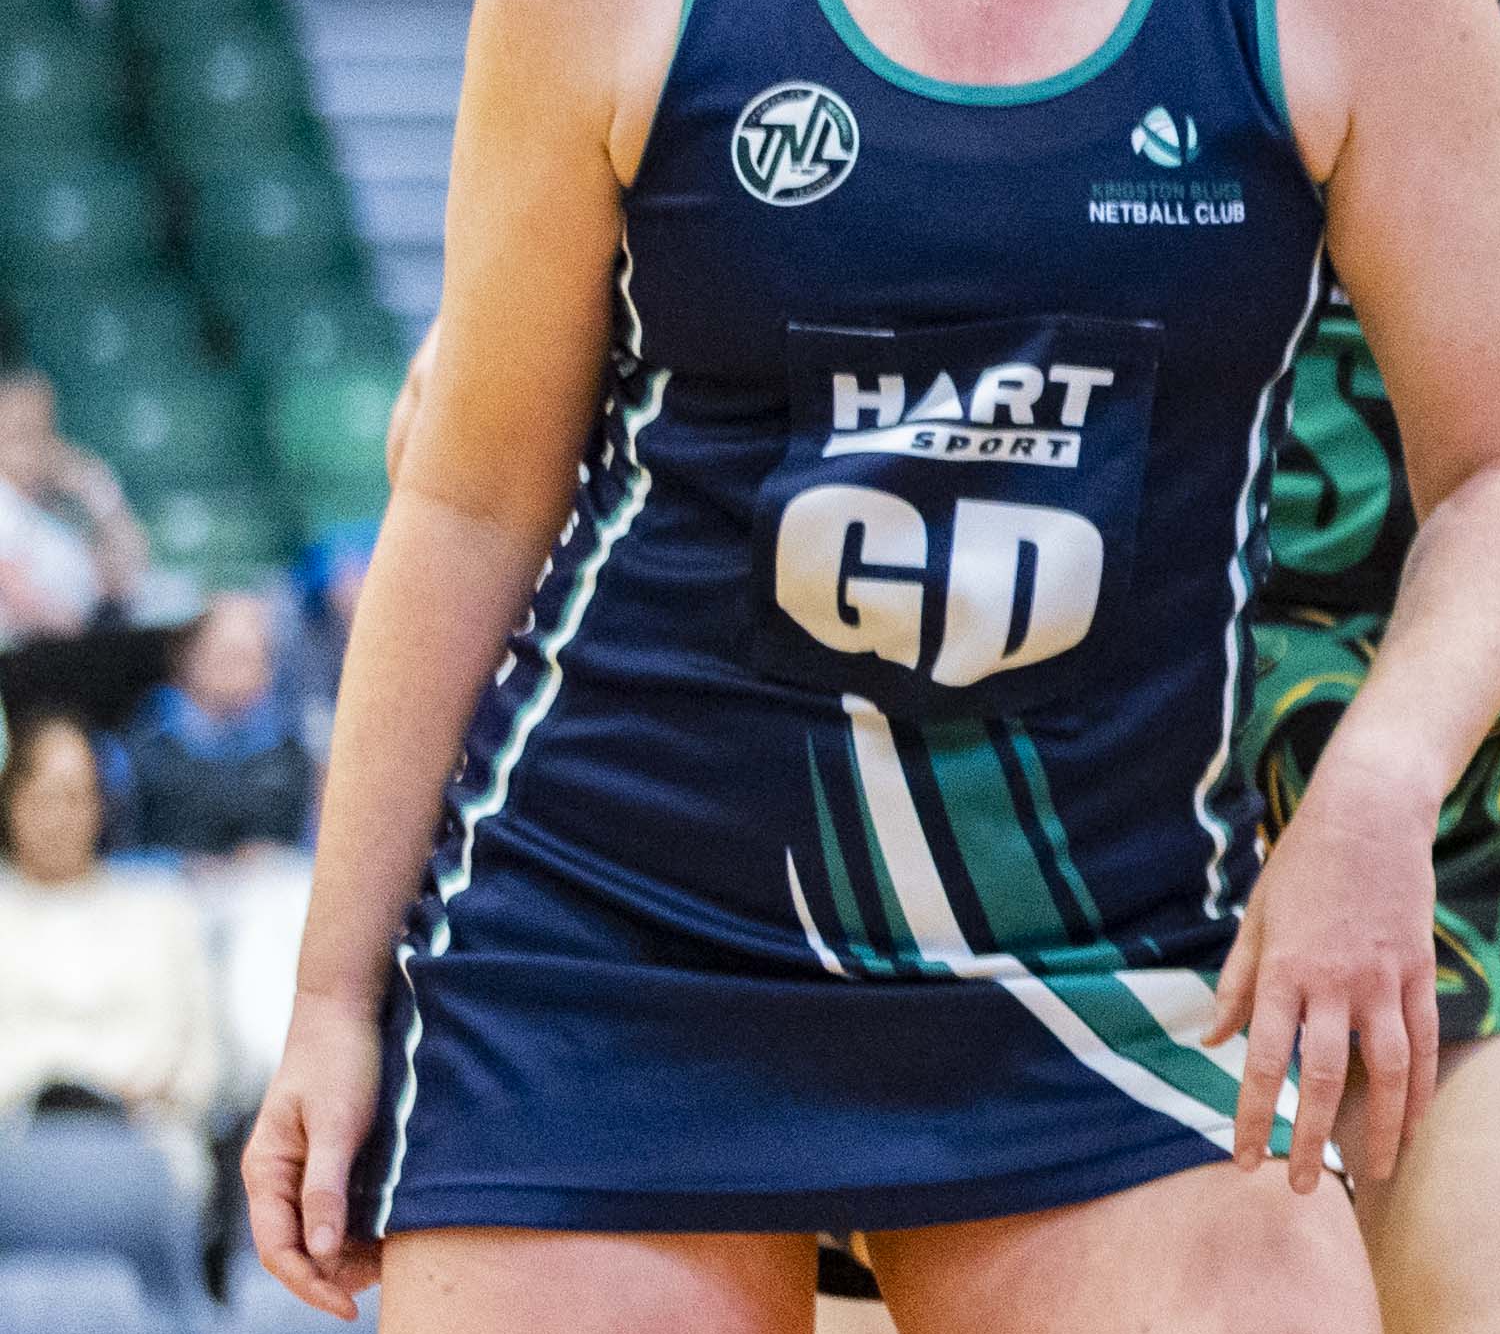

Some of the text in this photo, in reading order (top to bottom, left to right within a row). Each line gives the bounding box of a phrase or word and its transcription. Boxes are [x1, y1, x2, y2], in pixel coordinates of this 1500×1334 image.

[1089, 200, 1246, 226] NETBALL CLUB
[833, 363, 1114, 431] HART
[911, 431, 1071, 460] SPORT
[775, 483, 1104, 687] GD
